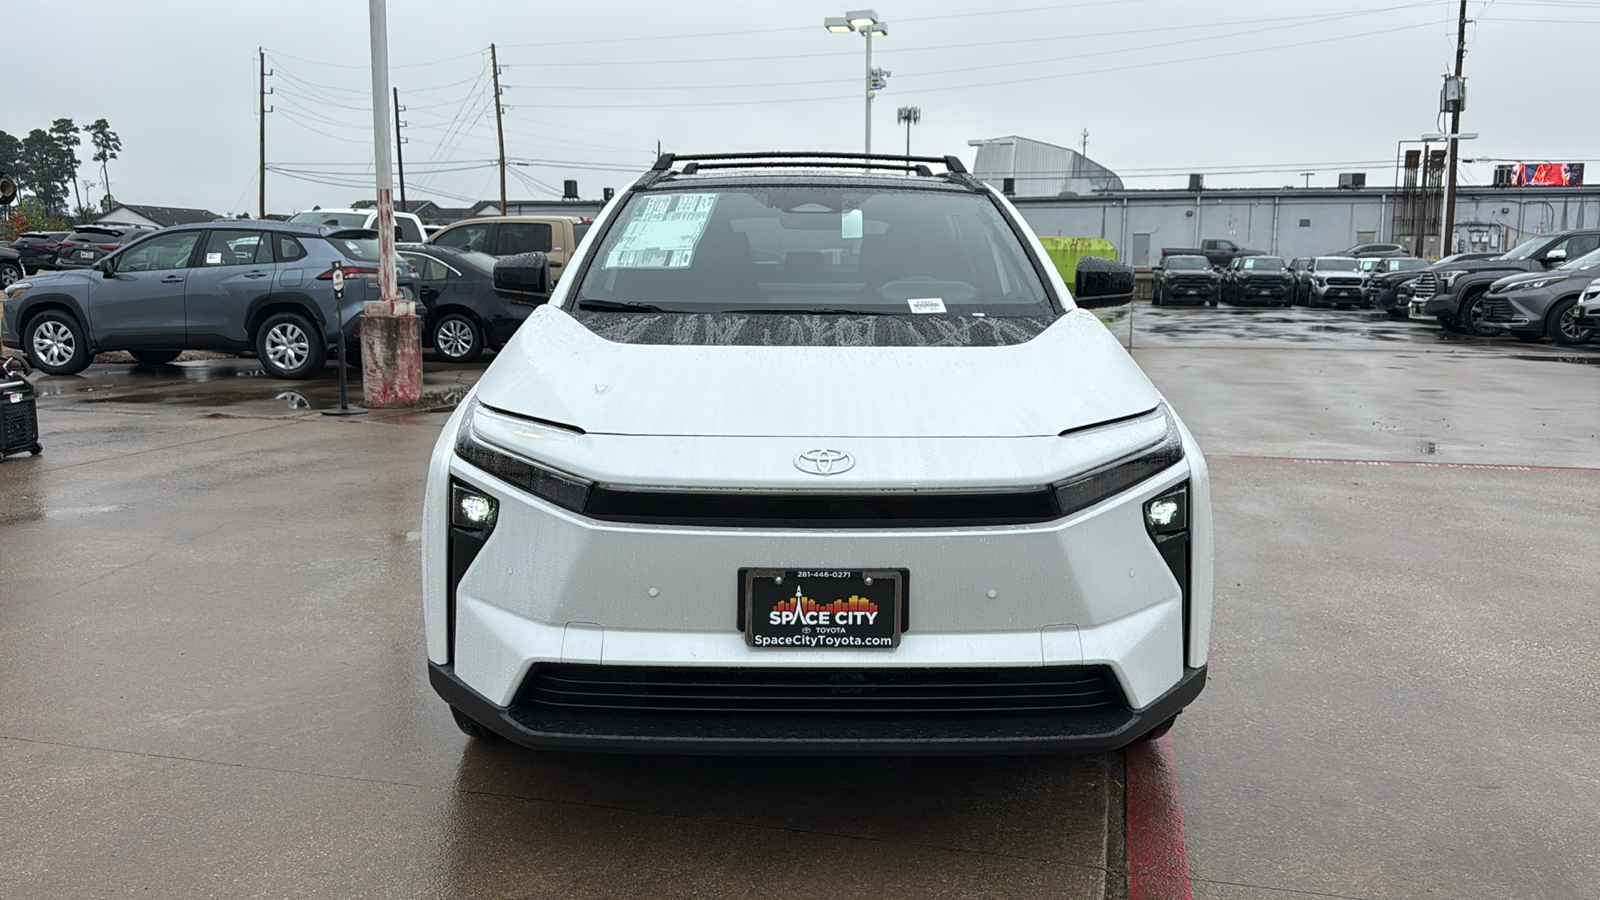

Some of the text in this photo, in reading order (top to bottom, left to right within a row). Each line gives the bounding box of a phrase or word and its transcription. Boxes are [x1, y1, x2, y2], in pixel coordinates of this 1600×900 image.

[769, 611, 878, 625] SPACE CITY
[754, 635, 892, 646] SpaceCityToyota.com
